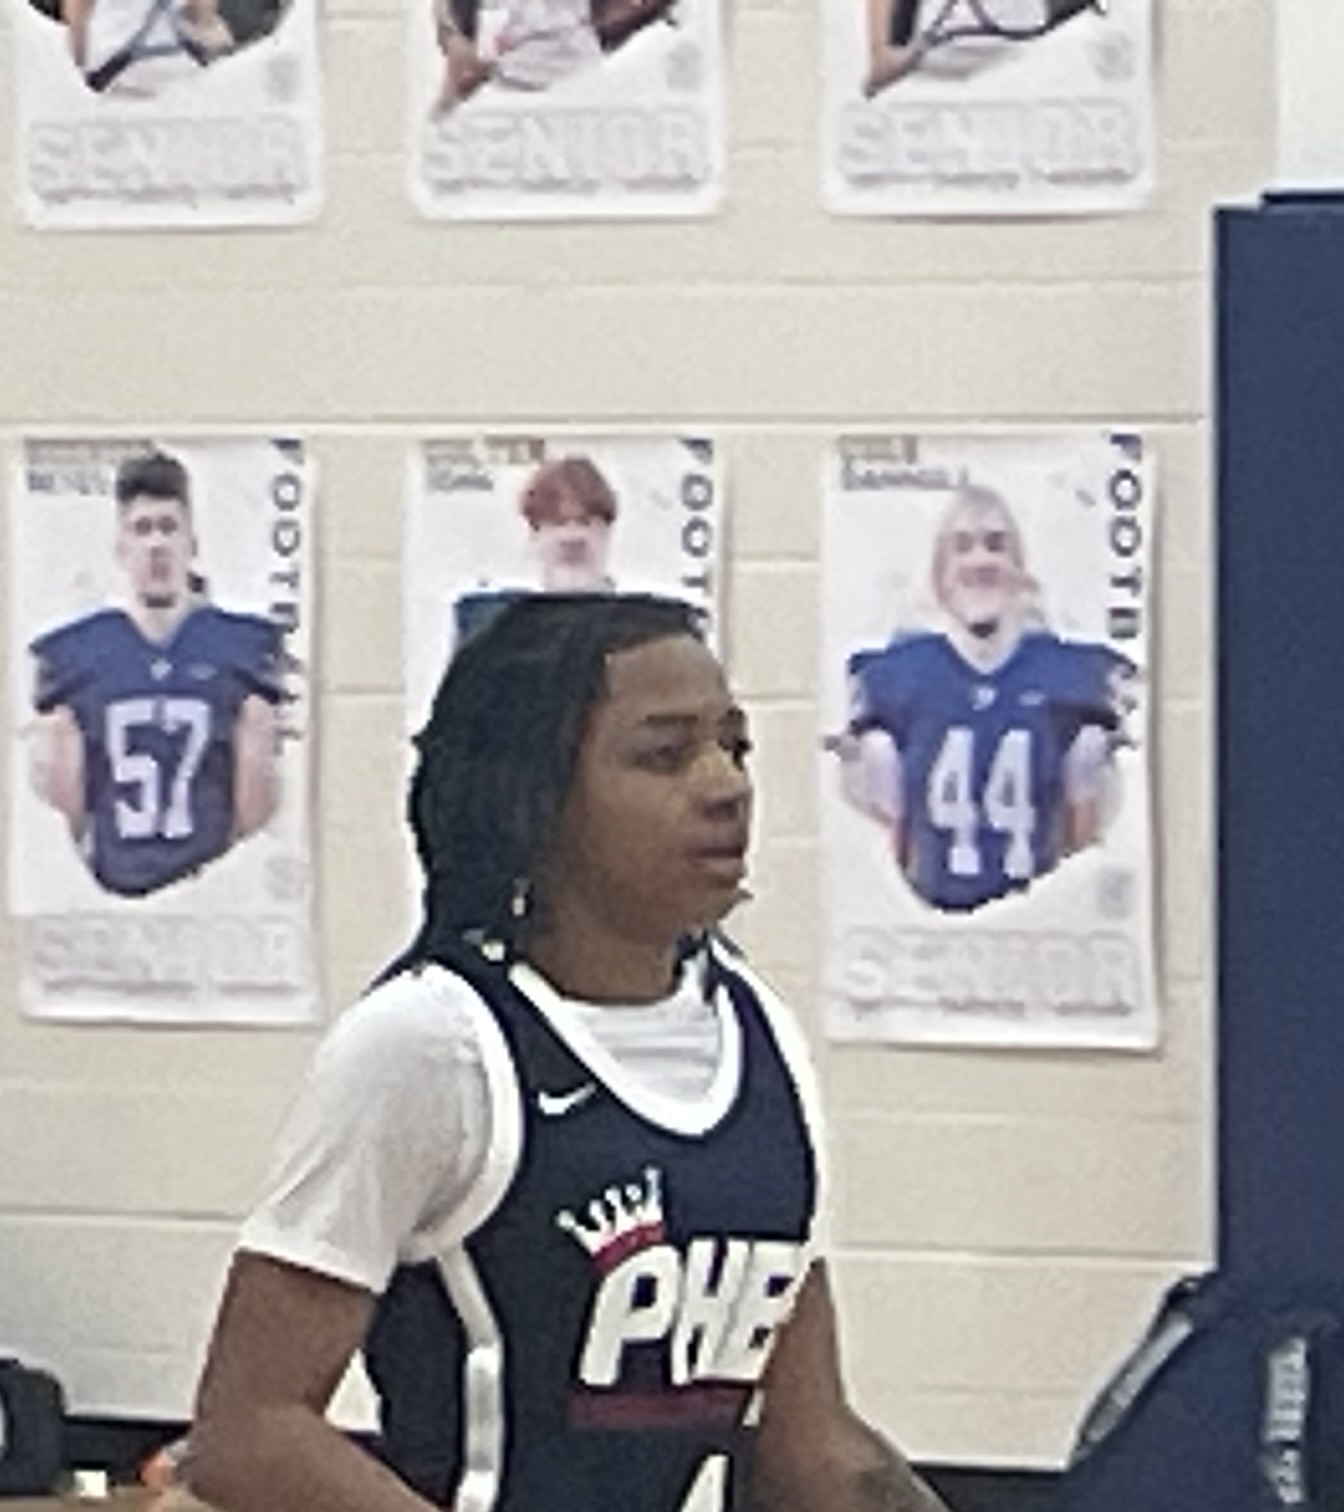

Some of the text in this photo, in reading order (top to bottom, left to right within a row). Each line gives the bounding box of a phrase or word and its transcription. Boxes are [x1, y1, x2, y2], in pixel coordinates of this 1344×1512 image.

[680, 438, 715, 600] FOOT
[105, 699, 212, 840] 57
[925, 727, 1036, 878] 44
